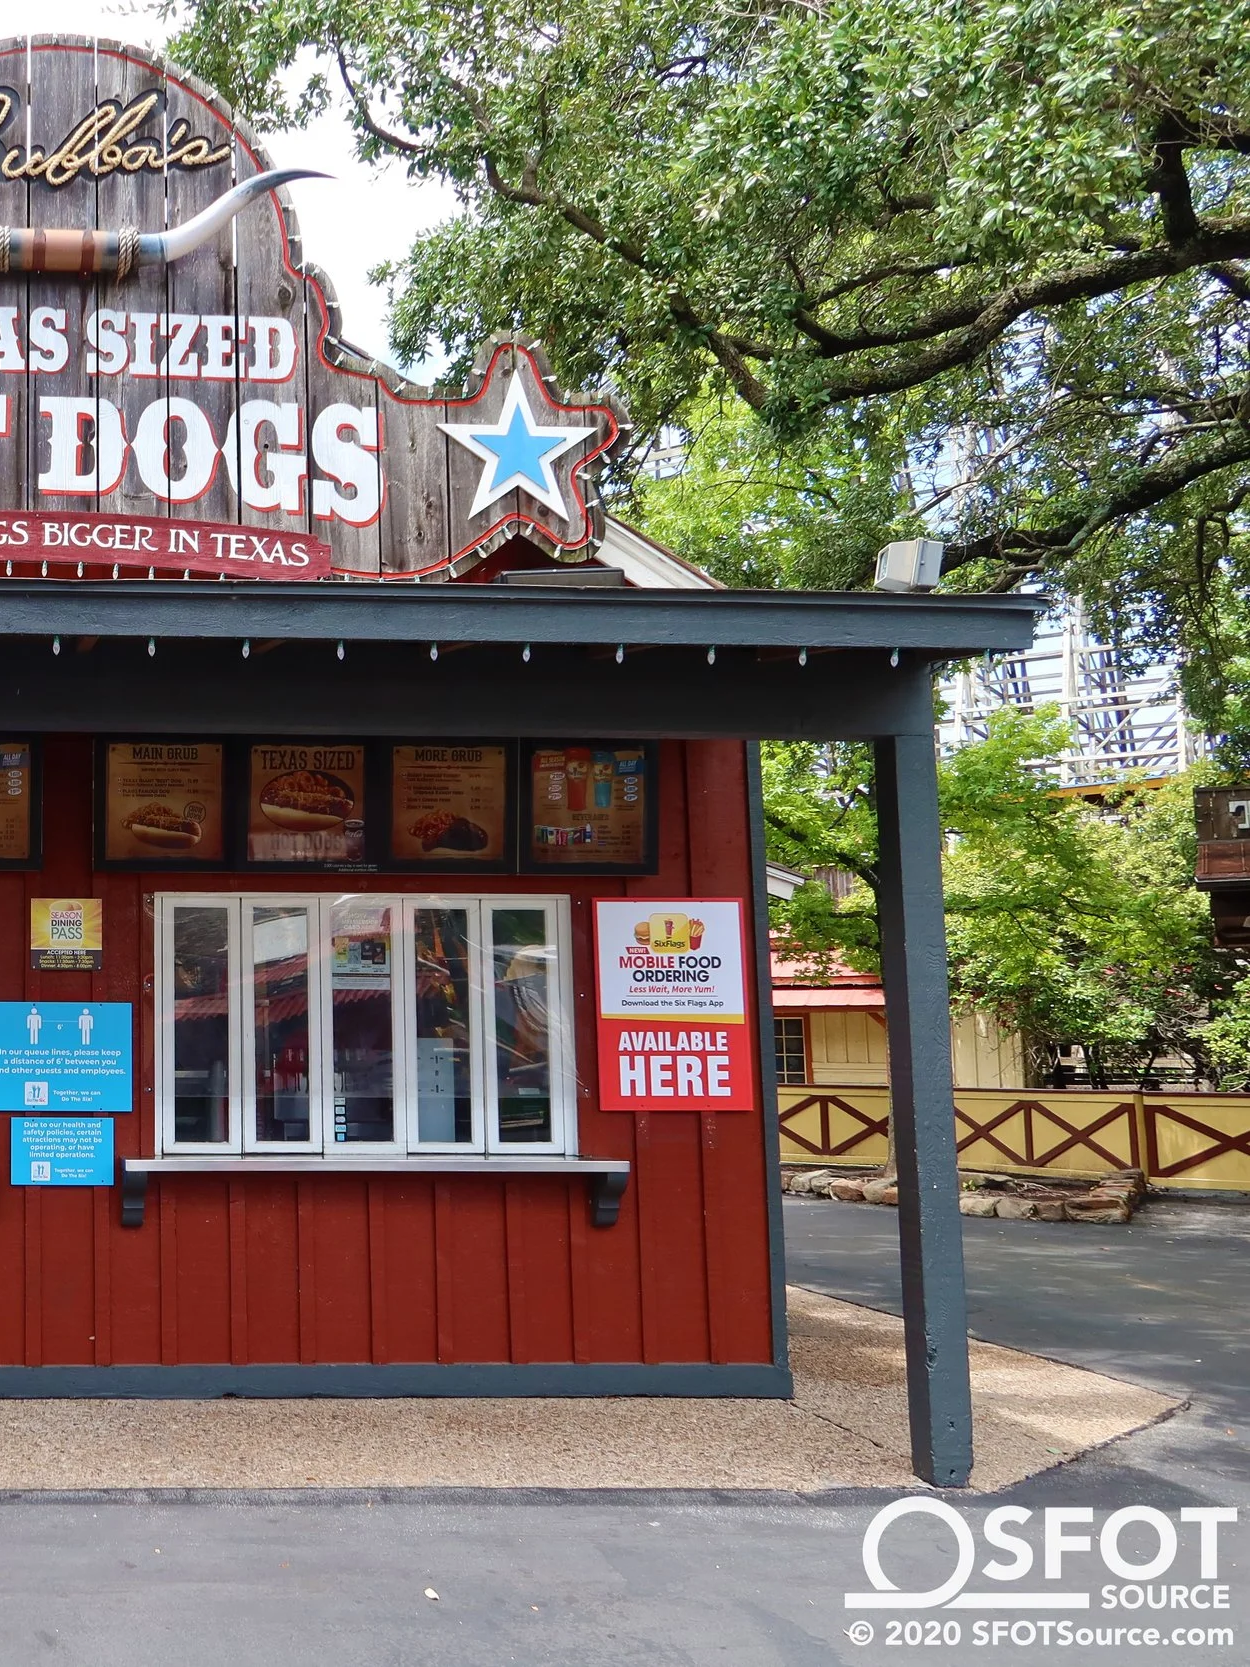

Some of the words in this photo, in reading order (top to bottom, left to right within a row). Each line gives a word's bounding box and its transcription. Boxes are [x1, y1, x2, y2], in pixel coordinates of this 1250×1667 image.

[86, 309, 300, 383] SIZED
[39, 396, 386, 528] DOGS
[42, 522, 156, 551] BIGGER
[168, 529, 198, 553] IN
[212, 533, 309, 566] TEXAS
[132, 747, 163, 760] MAIN
[167, 747, 198, 760] GRUB
[260, 750, 307, 770] TEXAS
[313, 750, 355, 770] SIZED
[414, 749, 448, 762] MORE
[451, 750, 482, 762] GRUB
[270, 833, 298, 850] HOT
[51, 911, 82, 919] SEASON
[51, 927, 82, 939] PASS
[654, 940, 685, 948] SixFlags
[619, 956, 674, 969] MOBILE
[678, 956, 722, 969] FOOD
[633, 970, 709, 982] ORDERING
[629, 985, 647, 994] Less
[648, 985, 670, 995] Wait,
[672, 985, 692, 994] More
[694, 985, 715, 994] Yum!
[687, 1000, 708, 1008] Flags
[709, 1000, 724, 1008] App
[619, 1032, 728, 1051] AVAILABLE
[73, 1049, 100, 1058] please
[101, 1049, 121, 1057] keep
[35, 1068, 62, 1076] guests
[80, 1067, 126, 1076] employees.
[619, 1055, 731, 1096] HERE
[23, 1129, 44, 1137] safety
[46, 1129, 75, 1137] policies,
